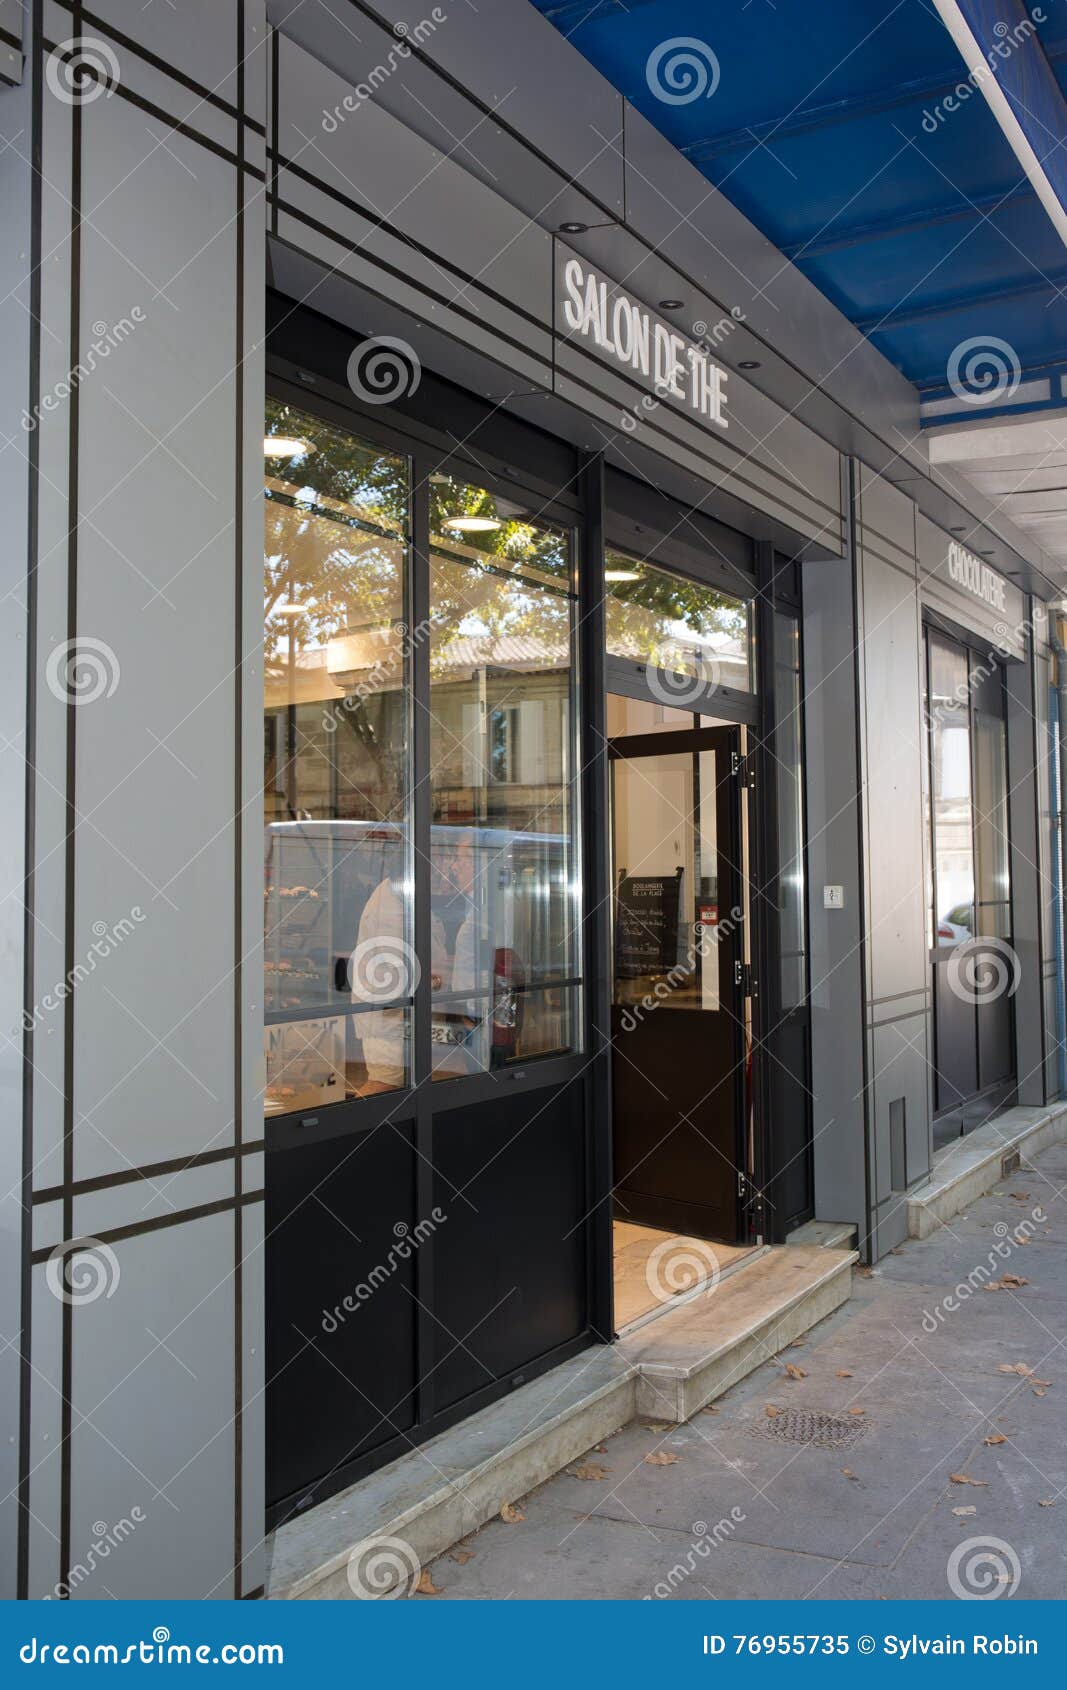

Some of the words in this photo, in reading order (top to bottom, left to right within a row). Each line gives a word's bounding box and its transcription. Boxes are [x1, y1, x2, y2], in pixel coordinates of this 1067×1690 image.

[564, 259, 649, 376] SALON
[654, 323, 686, 400] DE
[687, 347, 729, 428] THE
